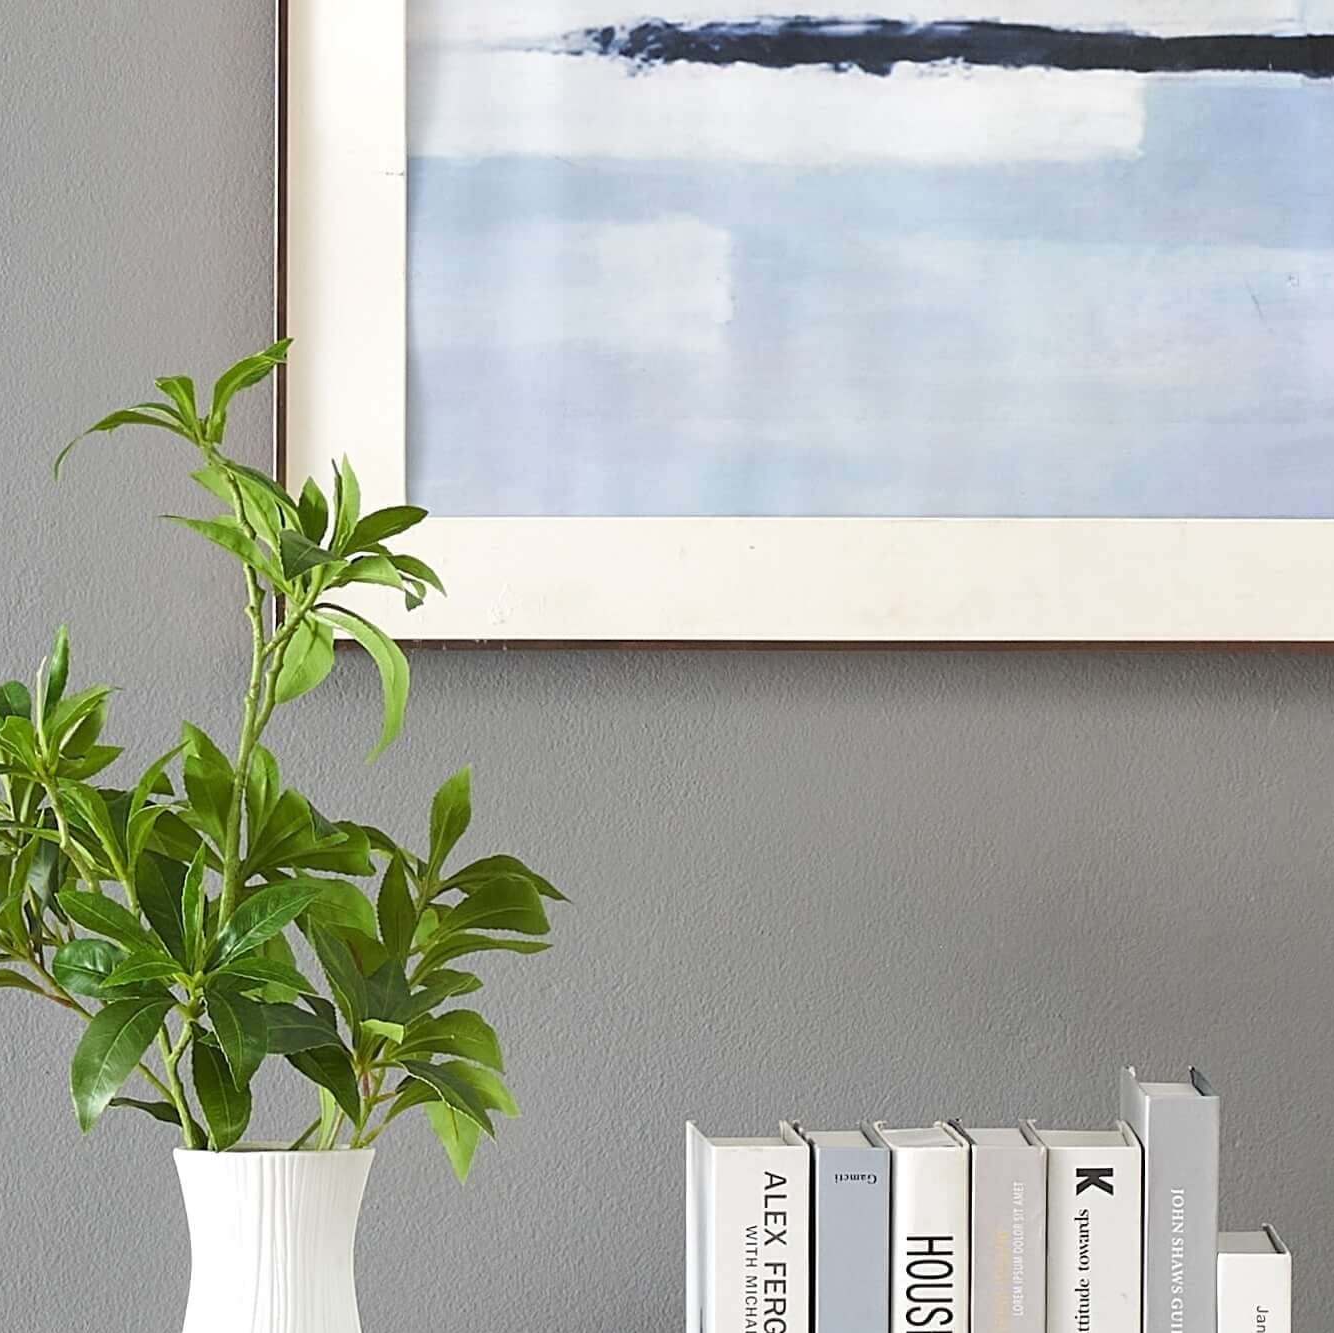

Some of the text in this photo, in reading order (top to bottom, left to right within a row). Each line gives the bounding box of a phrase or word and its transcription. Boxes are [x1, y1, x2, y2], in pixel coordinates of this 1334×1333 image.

[1076, 1168, 1113, 1195] K
[764, 1172, 787, 1245] ALEX
[1171, 1189, 1184, 1233] JOHN
[746, 1225, 757, 1267] WITH
[1074, 1209, 1089, 1271] towards
[1171, 1237, 1184, 1294] SHAWS
